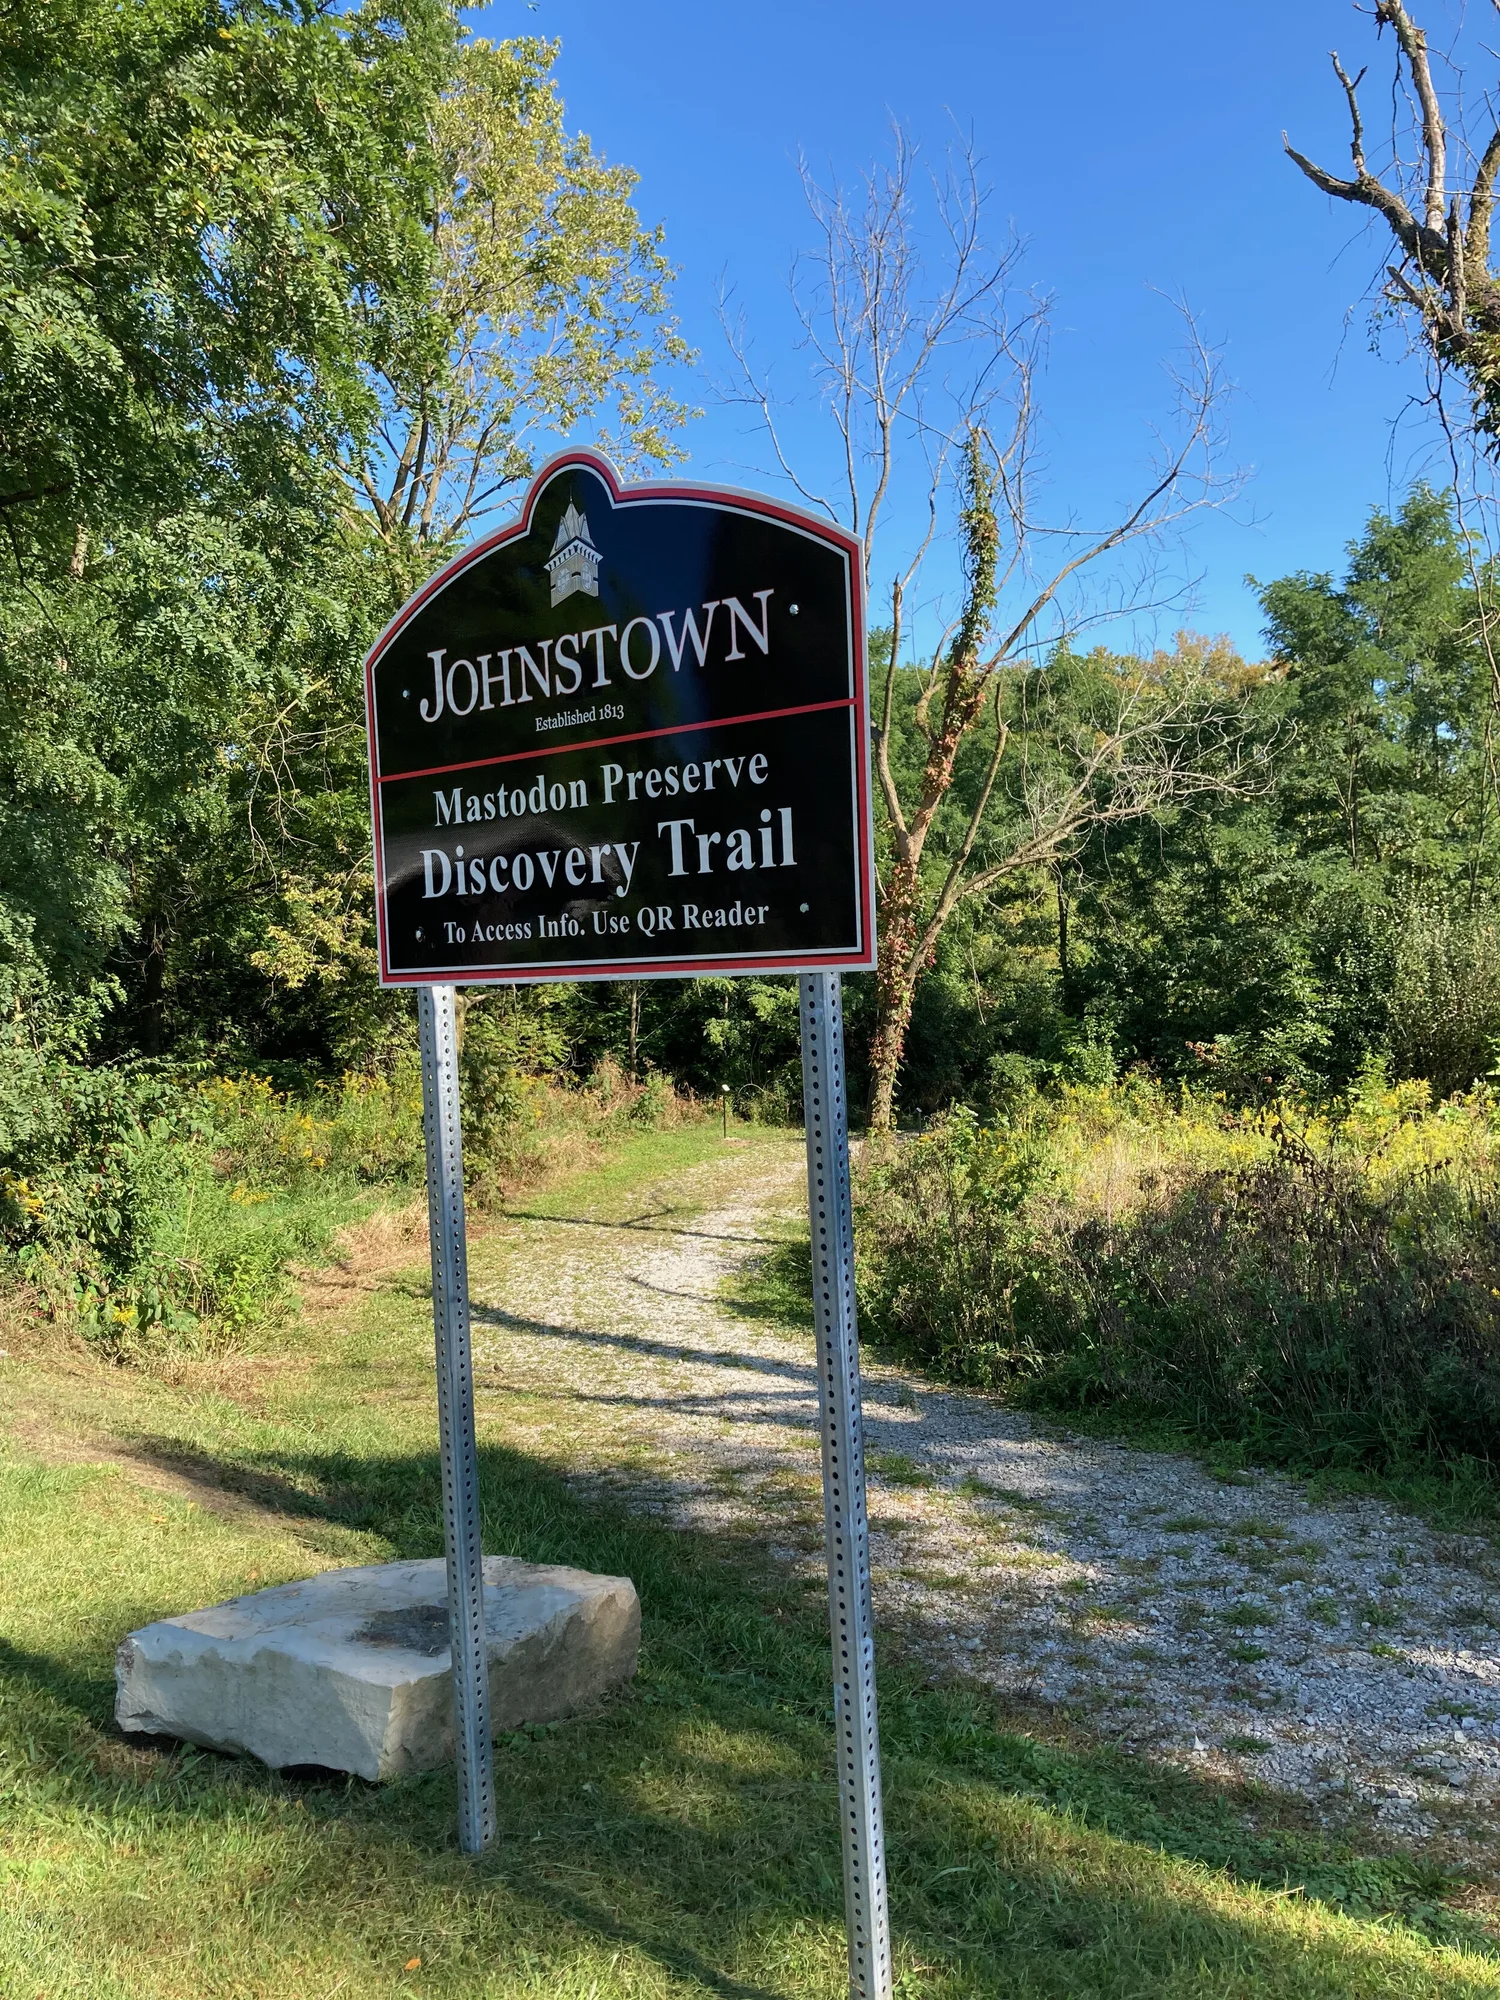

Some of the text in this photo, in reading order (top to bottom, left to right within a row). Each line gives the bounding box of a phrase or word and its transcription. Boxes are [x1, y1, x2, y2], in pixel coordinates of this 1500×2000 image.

[420, 589, 774, 723] JOHNSTOWN
[535, 704, 625, 733] Established 1813
[433, 753, 769, 827] Mastodon Preserve
[420, 807, 797, 898] Discovery Trail
[444, 901, 769, 944] To Access Info. Use QR Reader
